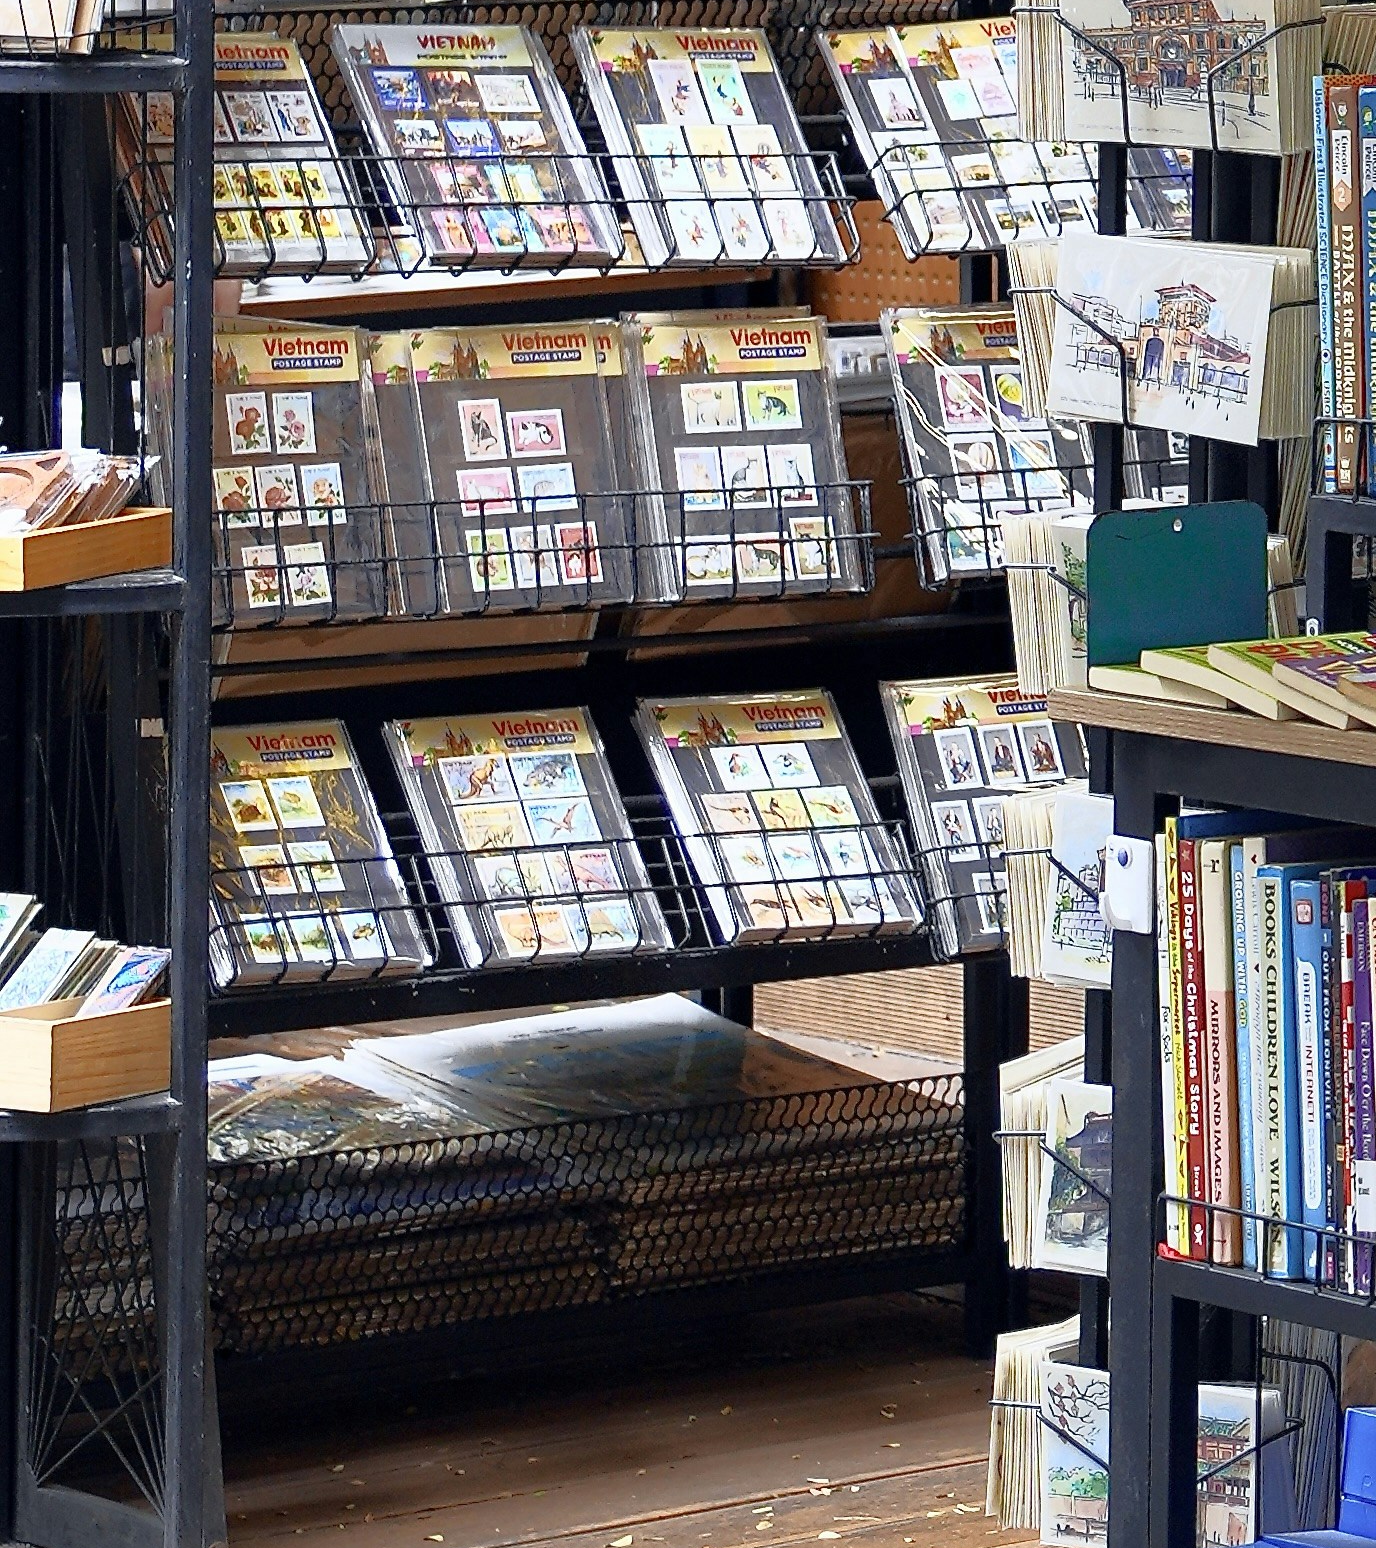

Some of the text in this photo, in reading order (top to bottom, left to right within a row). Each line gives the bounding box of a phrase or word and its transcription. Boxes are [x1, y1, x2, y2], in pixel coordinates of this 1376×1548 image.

[416, 34, 497, 51] VIETNAM
[676, 34, 759, 52] Vietnam
[217, 45, 289, 59] ietnam
[502, 333, 587, 351] Vietnam
[731, 329, 812, 347] Vietnam
[264, 338, 349, 356] Vietnam
[739, 347, 806, 359] POSTAGE STAMP
[272, 357, 343, 369] POSTAGE STAMP
[512, 351, 581, 363] POSTAGE STAMP
[742, 703, 826, 721] Vietnam
[492, 718, 578, 738] Vietnam
[756, 719, 823, 732] POSTAGE STAMP
[247, 732, 337, 752] Vietnam
[505, 735, 577, 748] POSTAGE STAMP
[260, 749, 334, 762] POSTAGE STAMP
[1264, 882, 1282, 1247] BOOKS CHILDREN LOVE WILSON
